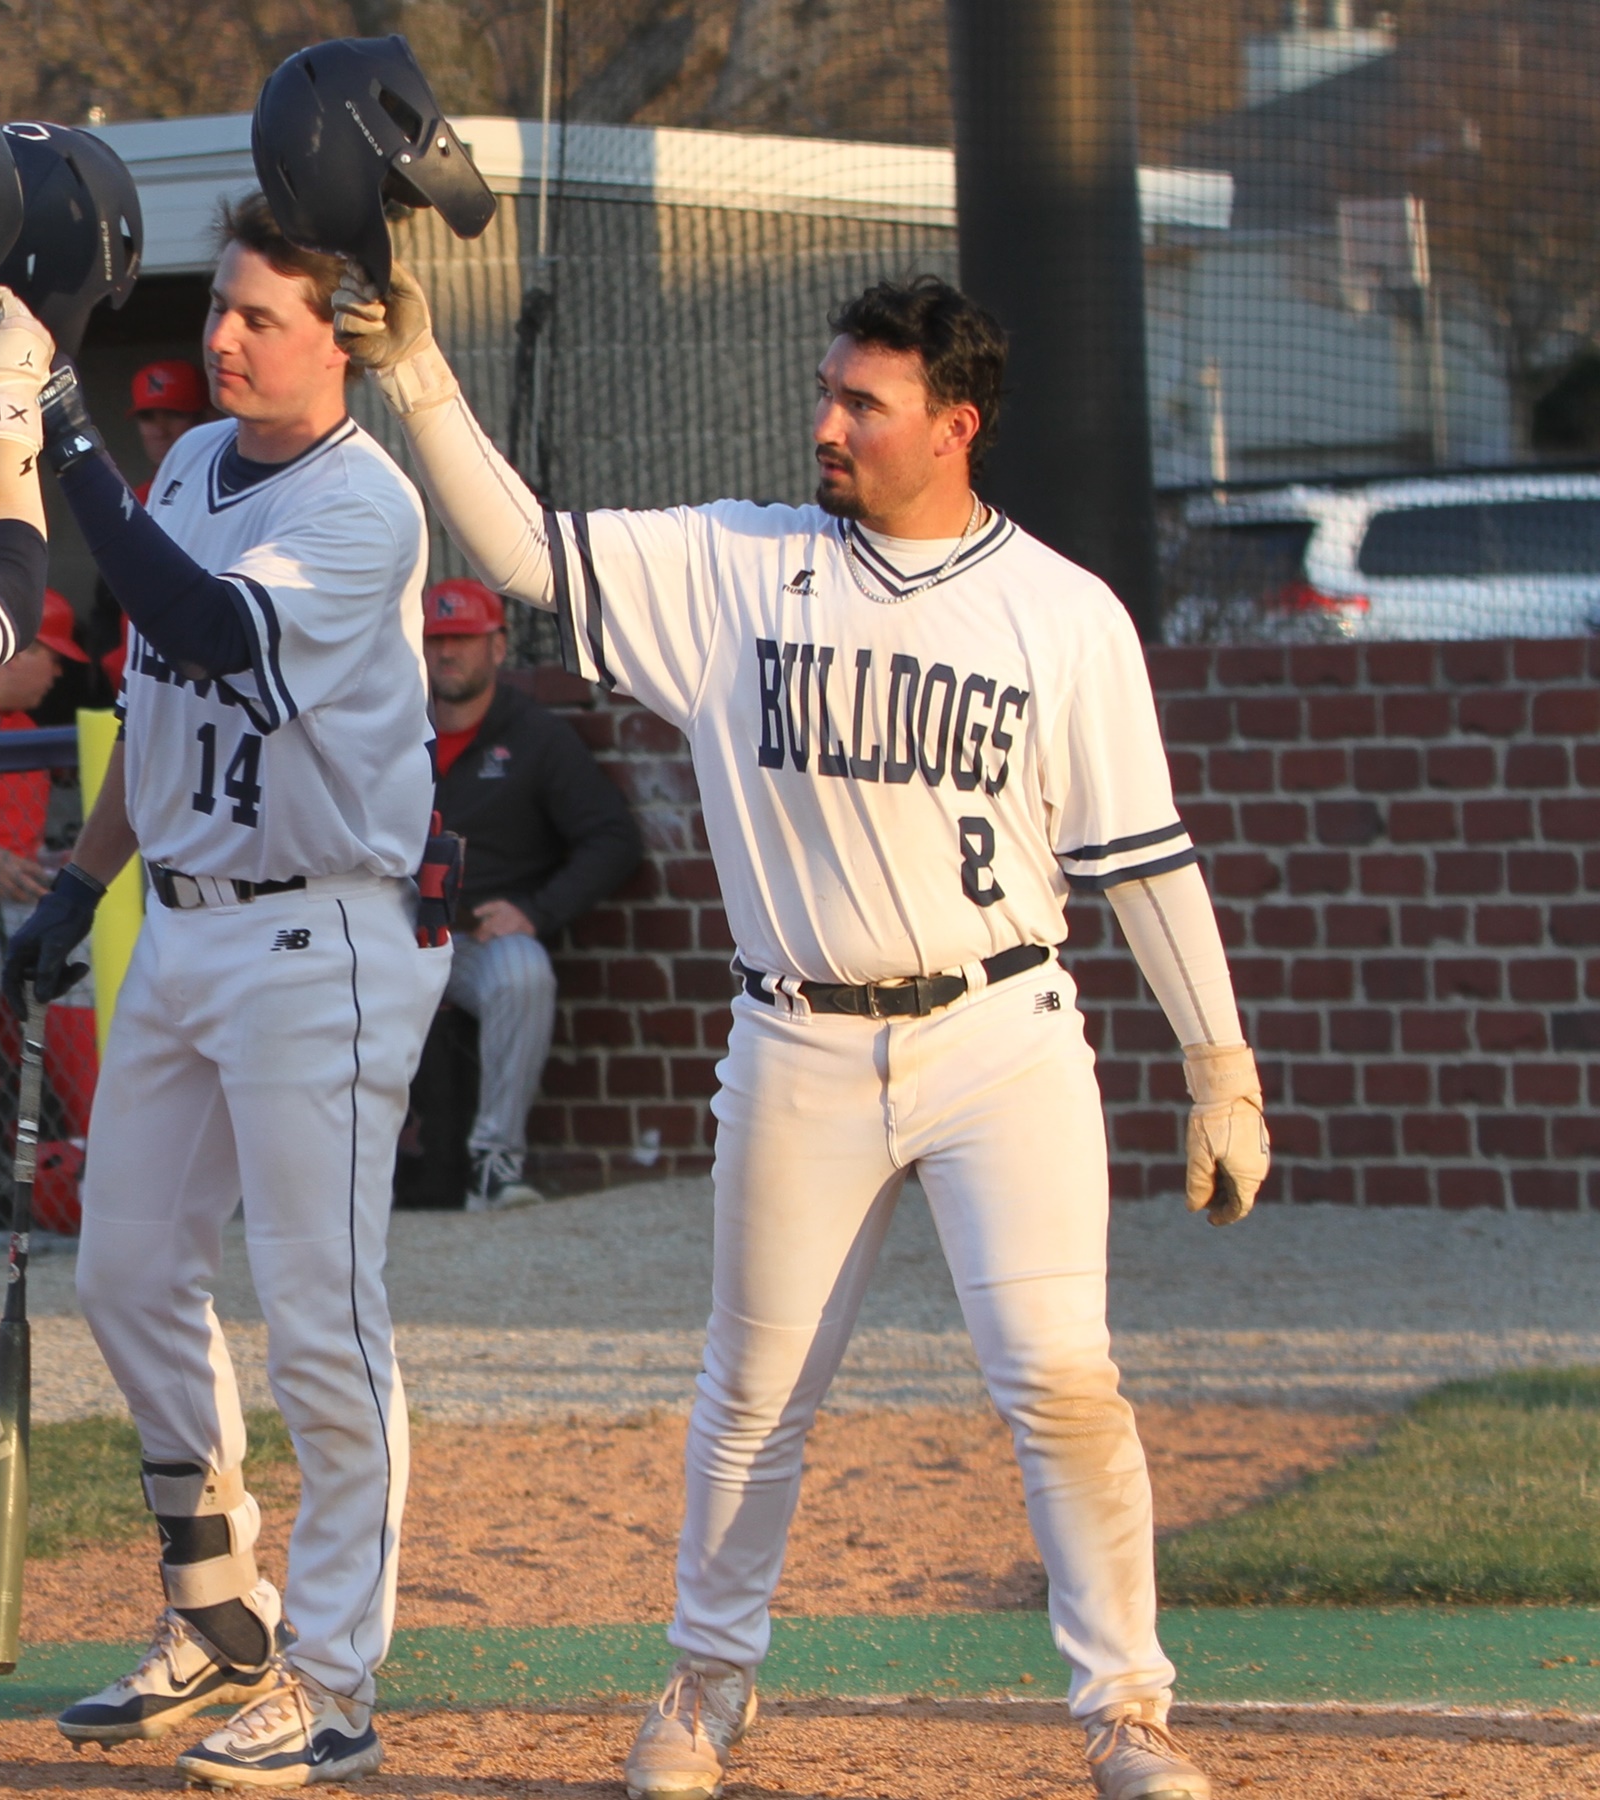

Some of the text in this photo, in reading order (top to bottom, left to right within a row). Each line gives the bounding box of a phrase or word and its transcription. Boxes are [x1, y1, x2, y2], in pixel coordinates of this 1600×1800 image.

[344, 100, 383, 156] EVOSHIELD
[756, 637, 1030, 799] BULLDOGS
[191, 721, 263, 829] 14
[957, 815, 1006, 908] 8
